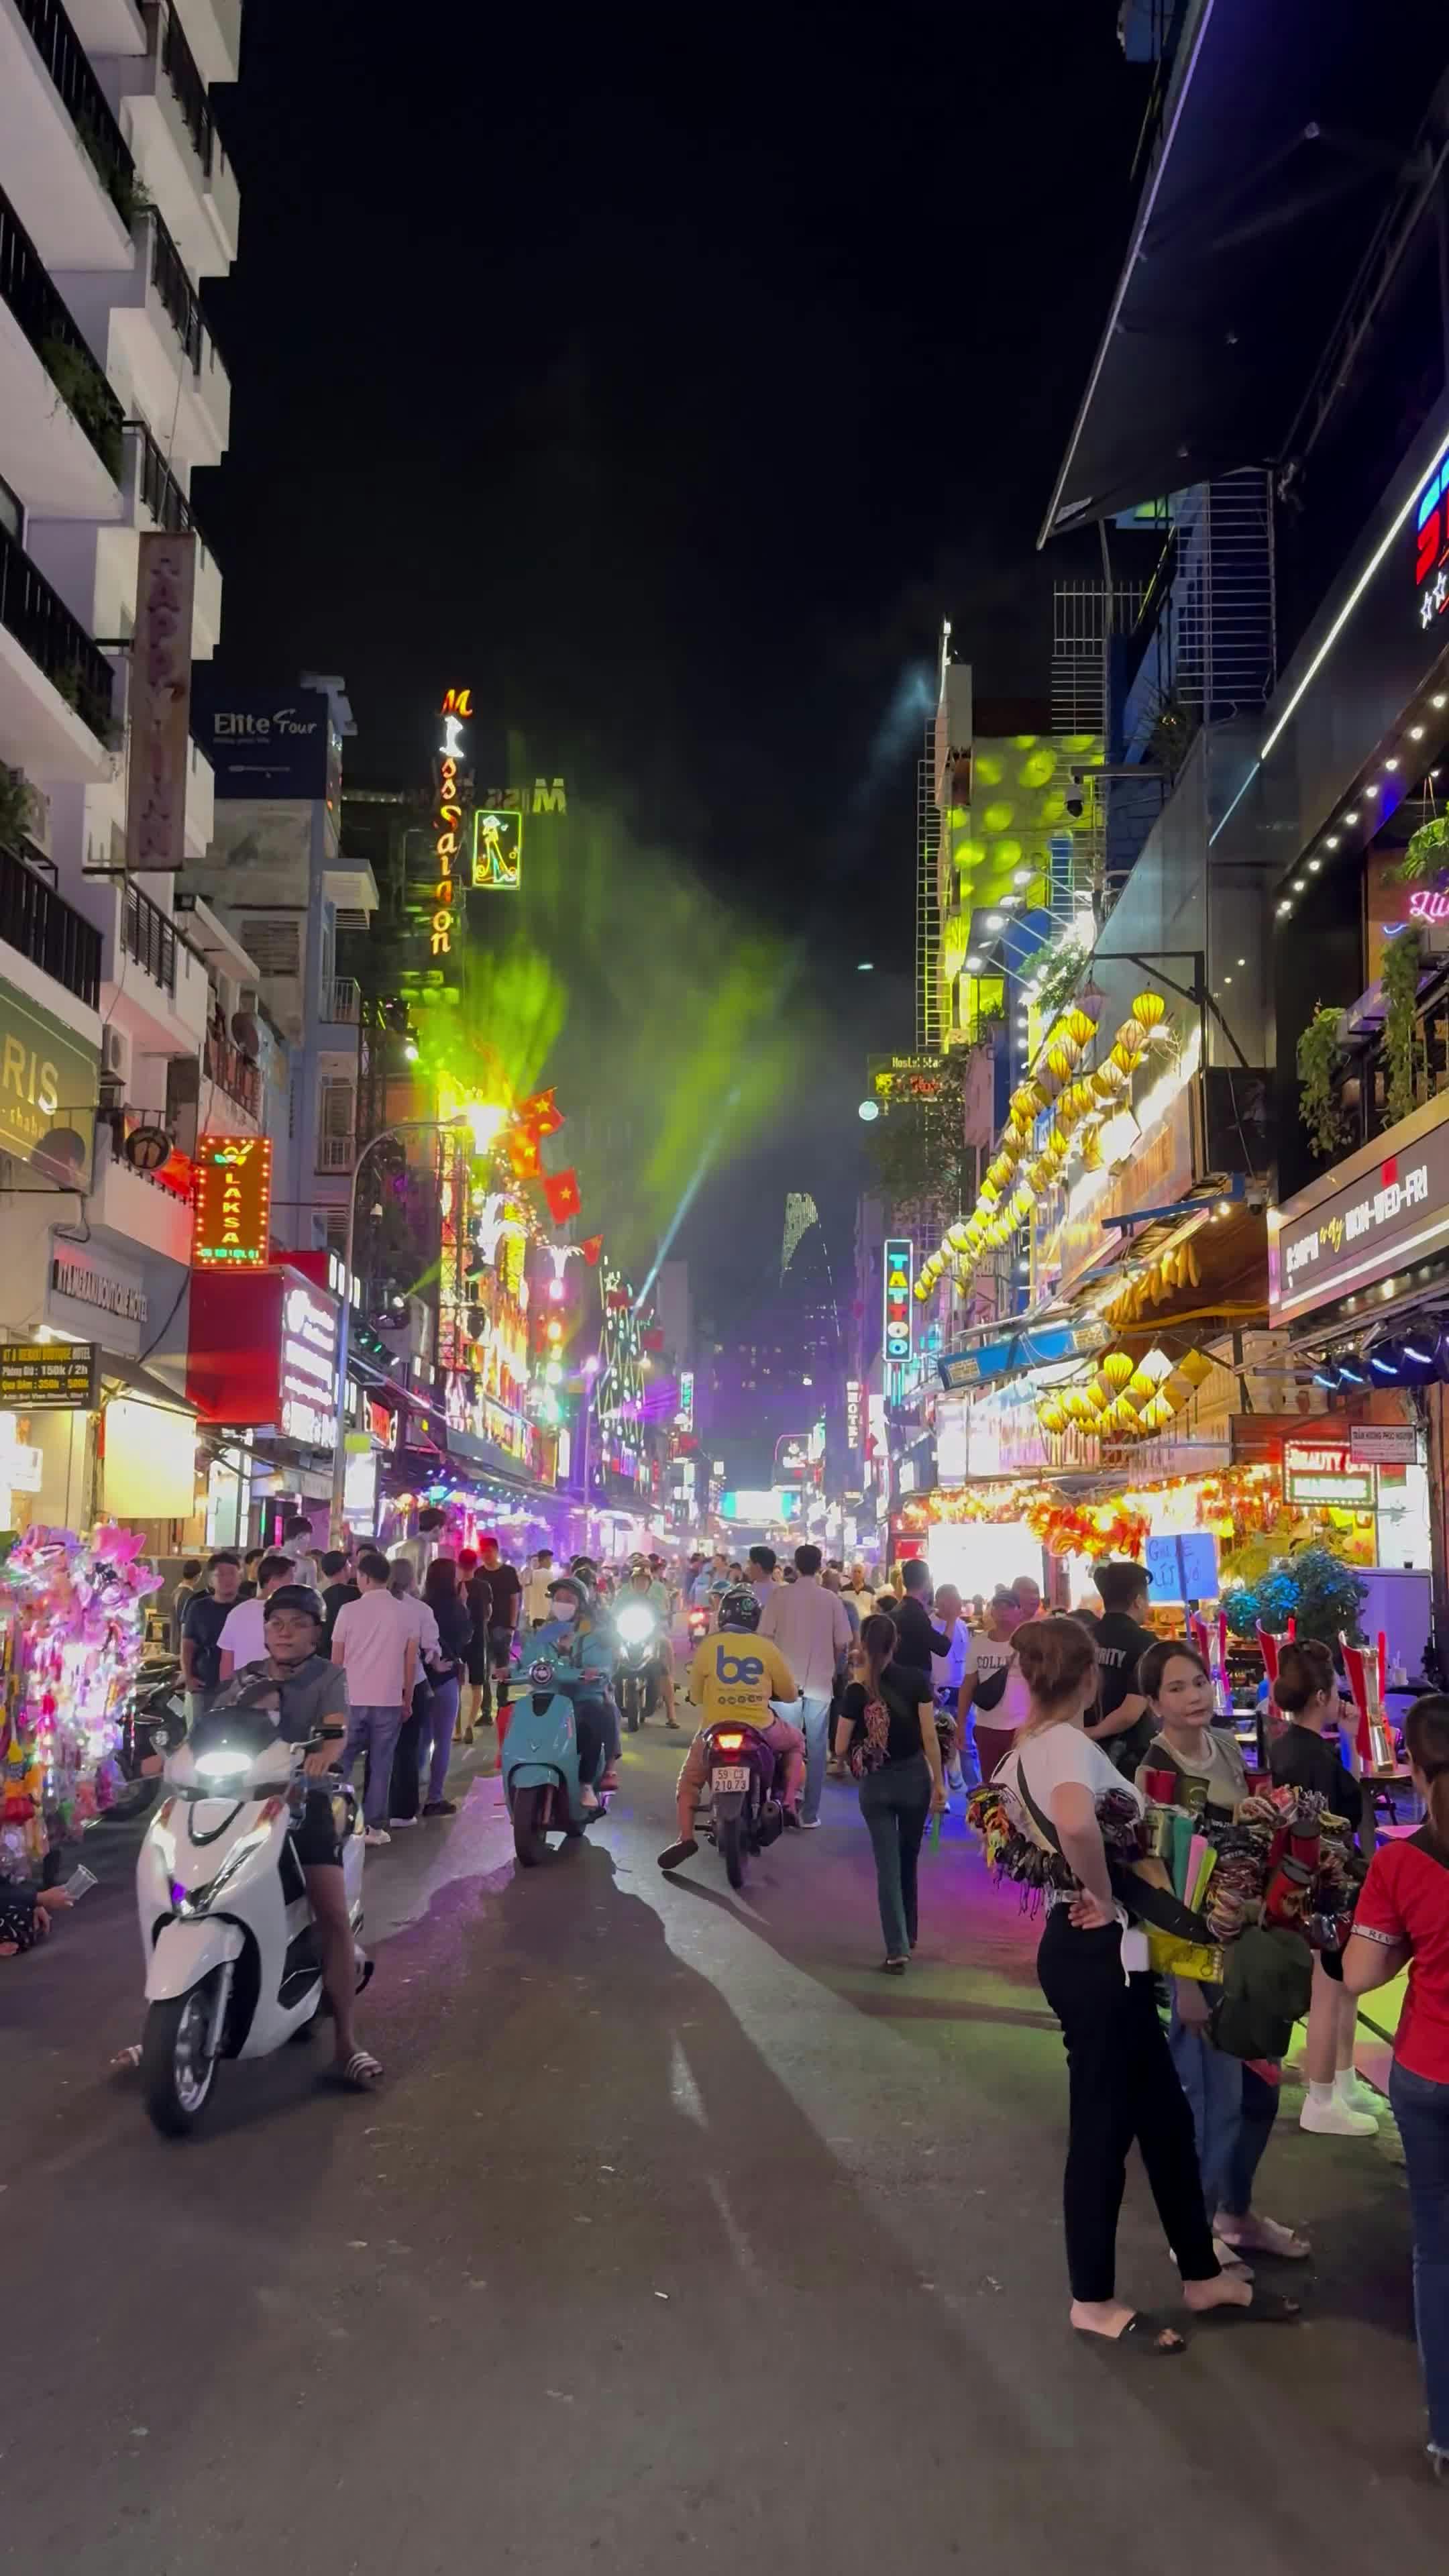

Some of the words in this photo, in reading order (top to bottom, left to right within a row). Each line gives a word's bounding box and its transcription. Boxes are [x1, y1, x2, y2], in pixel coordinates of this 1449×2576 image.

[214, 712, 270, 735] Elite
[272, 708, 317, 735] Tour
[221, 1173, 241, 1243] LAKSA
[888, 1254, 909, 1355] TATTOO
[41, 1364, 66, 1375] 150k
[74, 1364, 88, 1375] 2h
[716, 1645, 763, 1684] be
